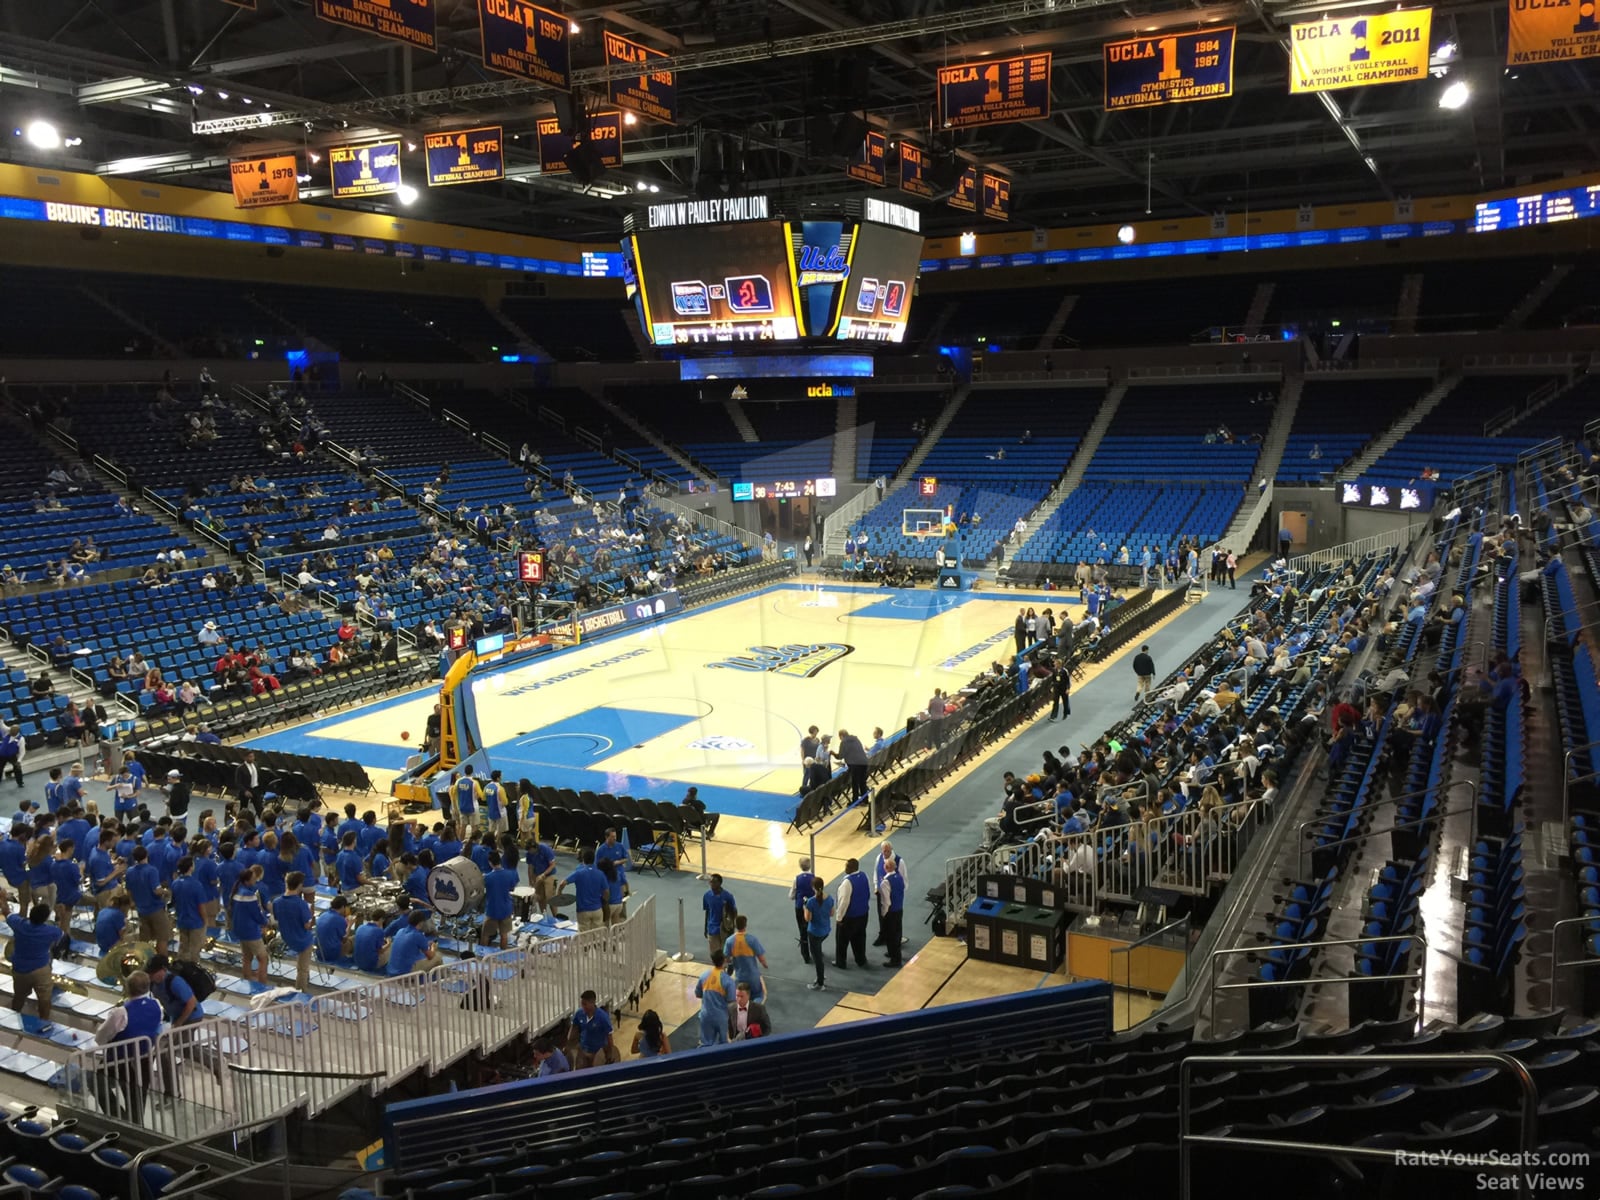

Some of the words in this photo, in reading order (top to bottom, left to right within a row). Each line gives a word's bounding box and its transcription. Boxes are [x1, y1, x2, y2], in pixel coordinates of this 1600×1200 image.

[322, 2, 374, 27] NATIONAL
[377, 18, 433, 46] CHAMPIONS
[486, 0, 523, 25] UCLA
[540, 19, 563, 42] 1967
[1295, 24, 1341, 41] UCLA
[1381, 27, 1420, 46] 2011
[608, 38, 636, 63] UCLA
[1109, 42, 1155, 62] UCLA
[1195, 39, 1220, 54] 1984
[1513, 48, 1576, 63] NATIONAL
[1195, 55, 1219, 68] 1987
[1353, 58, 1408, 70] VOLLEYBALL
[941, 67, 979, 85] UCLA
[1141, 78, 1194, 92] GYMNASTICS
[1300, 75, 1354, 88] NATIONAL
[1356, 66, 1419, 80] CHAMPIONS
[1110, 91, 1161, 106] NATIONAL
[1166, 83, 1225, 98] CHAMPIONS
[540, 123, 561, 136] UCL
[427, 135, 453, 149] UCLA
[474, 140, 499, 155] 1975
[332, 152, 355, 163] UCLA
[232, 165, 255, 174] UCLA
[272, 168, 293, 180] 1978
[46, 202, 100, 225] BRUINS
[104, 208, 187, 233] BASKETBALL
[648, 204, 676, 228] EDWIN
[677, 202, 687, 225] W
[688, 199, 721, 224] PAULEY
[723, 195, 768, 221] PAVILION
[775, 481, 795, 492] 7:43
[804, 484, 815, 496] 24
[522, 563, 539, 578] 30
[583, 609, 627, 633] BASKETBALL
[498, 667, 594, 696] WOODEN
[590, 648, 654, 668] COURT
